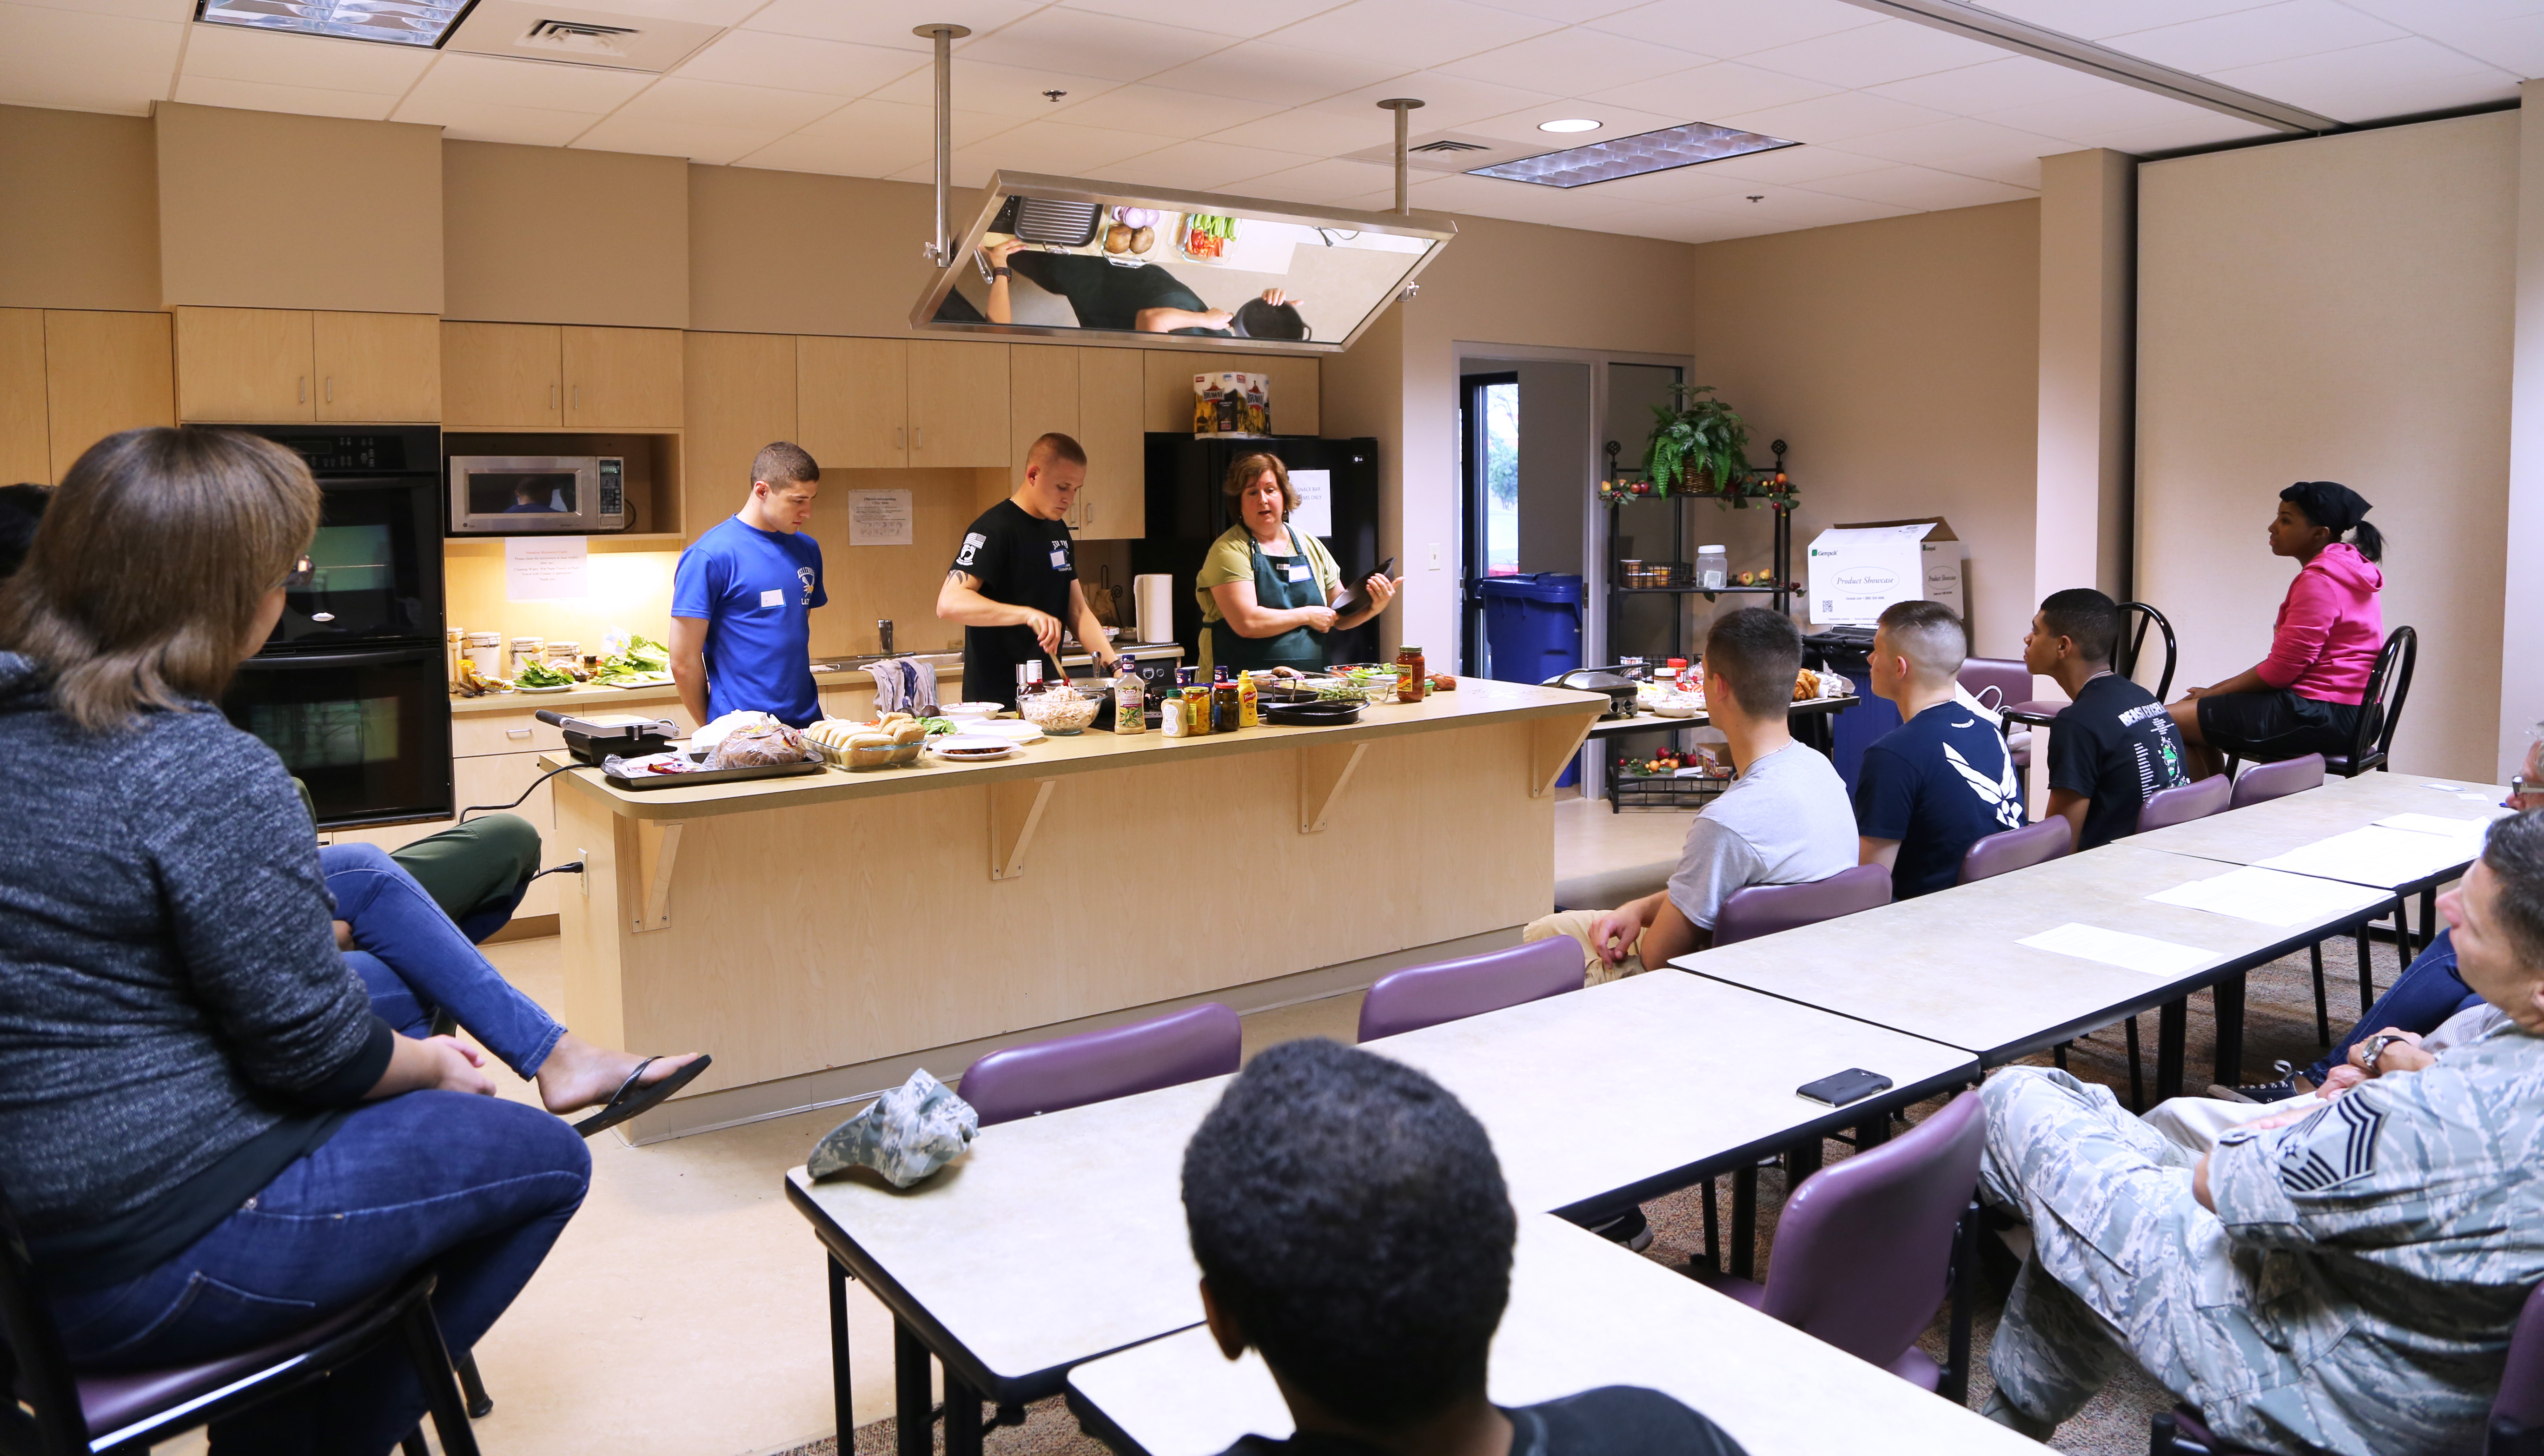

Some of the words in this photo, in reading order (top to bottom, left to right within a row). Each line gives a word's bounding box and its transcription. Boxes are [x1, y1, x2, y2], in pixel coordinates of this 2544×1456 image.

[1204, 390, 1223, 399] BRAWNY
[1247, 392, 1263, 405] BRAWNY
[1051, 540, 1060, 550] 331
[1836, 576, 1862, 585] Product
[1863, 576, 1895, 584] Showcase
[2118, 706, 2147, 727] BEAST
